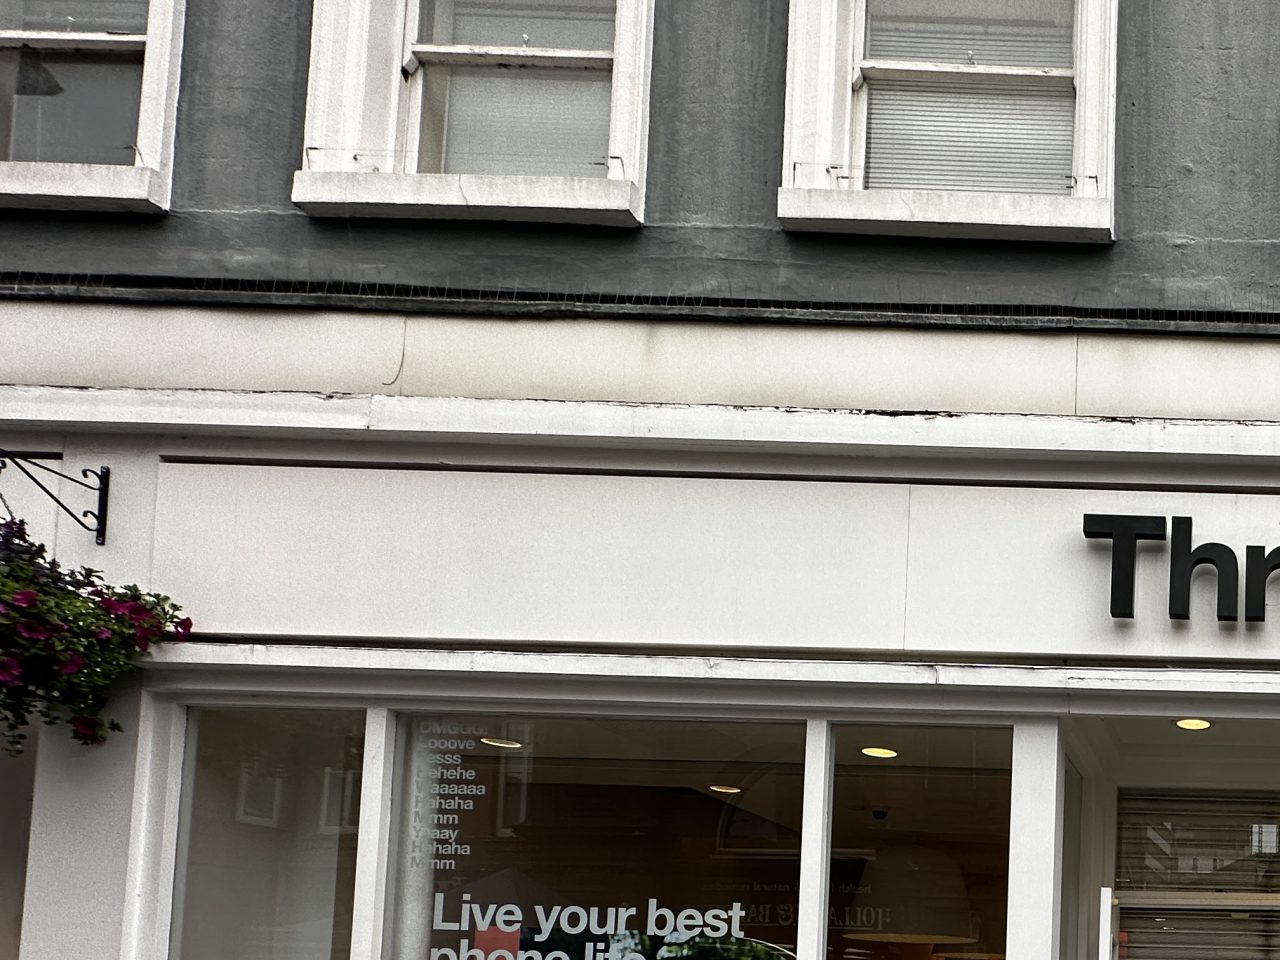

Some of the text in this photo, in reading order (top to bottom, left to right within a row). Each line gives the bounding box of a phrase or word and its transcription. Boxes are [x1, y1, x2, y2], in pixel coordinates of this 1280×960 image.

[419, 737, 476, 750] Looove
[415, 751, 462, 764] esss
[413, 826, 459, 842] Yaay
[432, 893, 522, 932] Live
[534, 902, 637, 942] your
[647, 899, 746, 938] best
